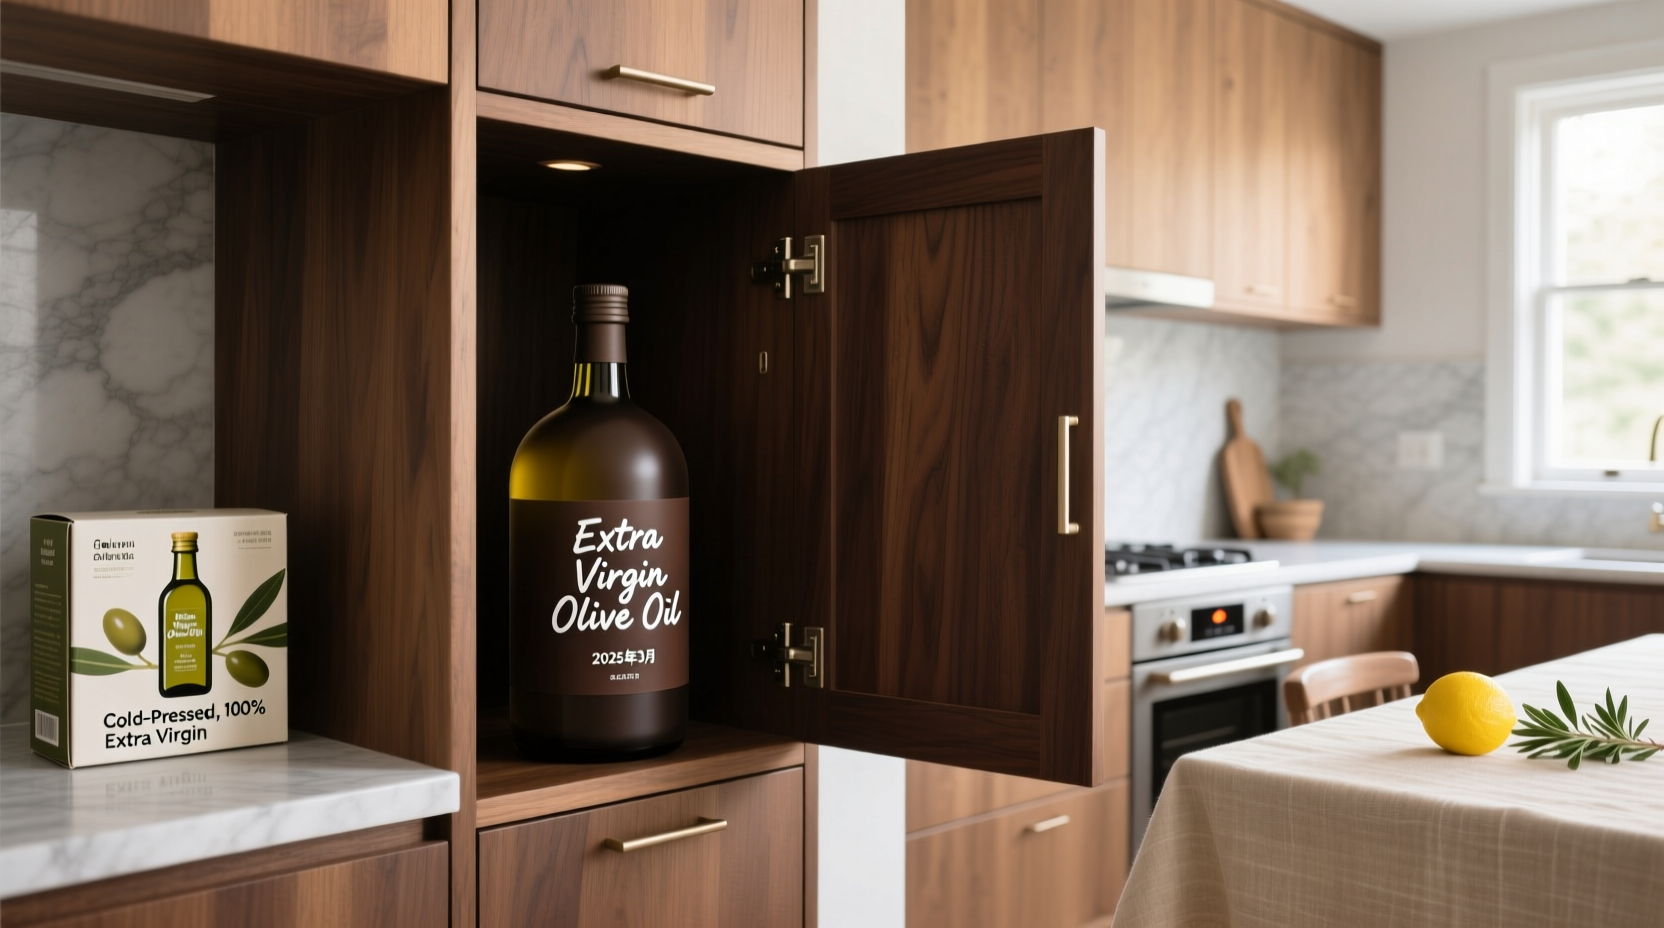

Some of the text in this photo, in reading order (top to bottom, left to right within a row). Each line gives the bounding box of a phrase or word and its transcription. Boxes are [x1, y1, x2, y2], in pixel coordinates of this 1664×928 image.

[573, 517, 664, 555] Extra
[576, 557, 668, 605] Virgin
[551, 590, 682, 634] Olive Oil
[103, 699, 266, 729] Cold-Pressed, 100%
[105, 726, 207, 750] Extra Virgin
